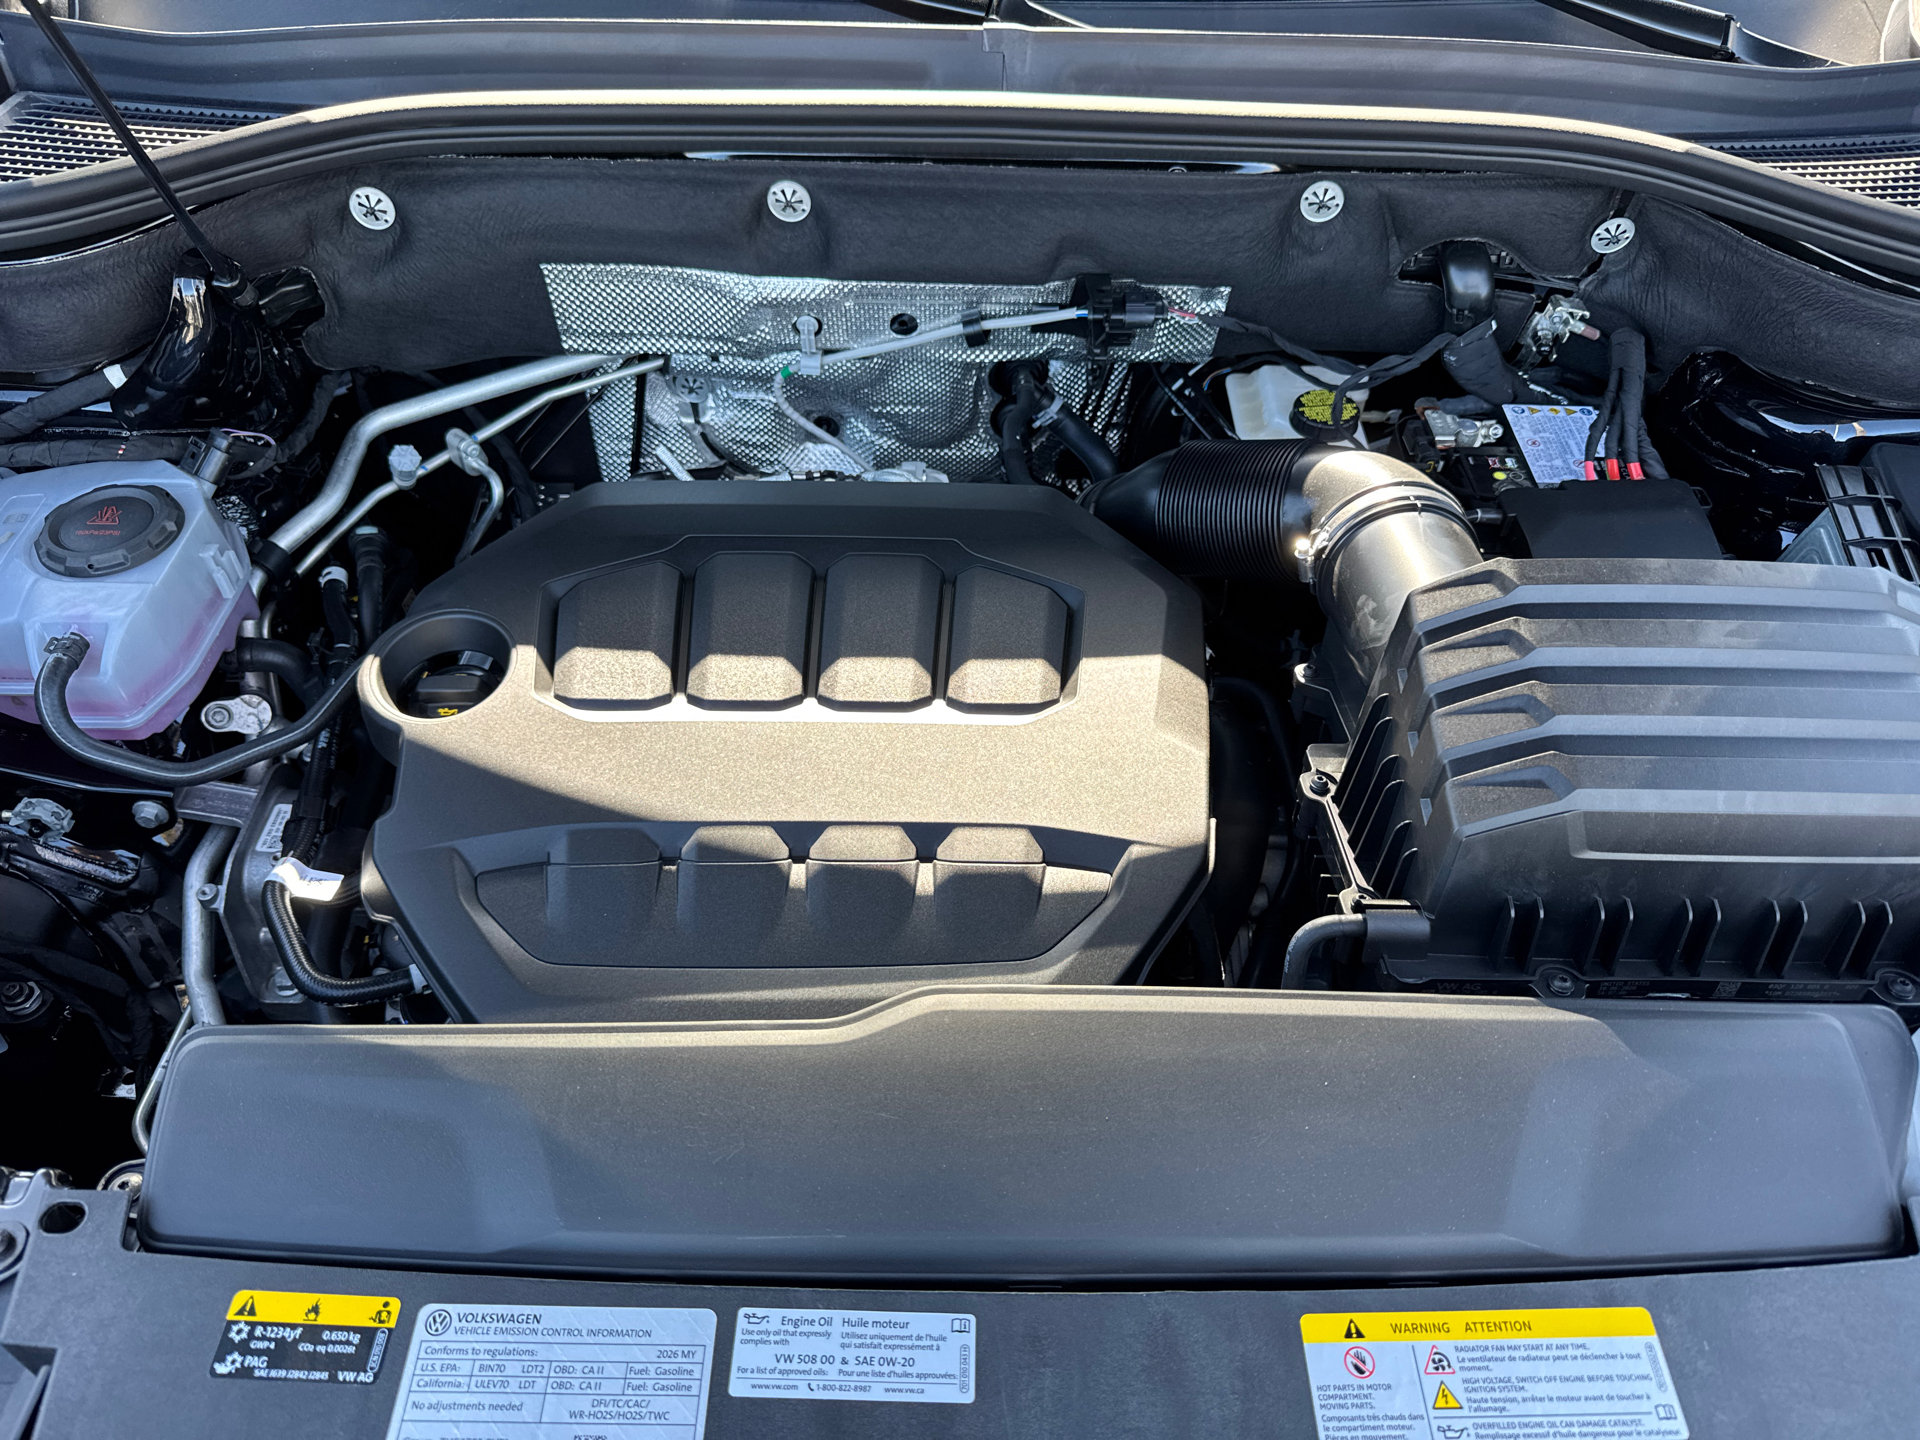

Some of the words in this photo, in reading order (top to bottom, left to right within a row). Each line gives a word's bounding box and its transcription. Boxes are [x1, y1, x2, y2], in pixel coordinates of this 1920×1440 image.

[457, 1312, 542, 1324] VOLKSWAGEN
[781, 1316, 815, 1329] Engine
[818, 1317, 833, 1327] Oil
[842, 1318, 869, 1328] Huile
[871, 1319, 910, 1329] moteur
[454, 1326, 491, 1335] VEHICLE
[493, 1326, 538, 1336] EMISSION
[541, 1328, 584, 1337] CONTROL
[586, 1328, 652, 1338] INFORMATION
[1390, 1322, 1450, 1334] WARNING
[1464, 1320, 1532, 1333] ATTENTION
[254, 1325, 303, 1342] R-1234yf
[322, 1330, 347, 1340] 0.650
[349, 1331, 361, 1344] kg
[756, 1329, 771, 1338] only
[798, 1330, 832, 1340] expressly
[841, 1332, 867, 1340] Utilisez
[869, 1332, 913, 1342] uniquement
[925, 1334, 947, 1342] l'huile
[740, 1338, 771, 1347] complies
[840, 1341, 852, 1350] qui
[854, 1341, 882, 1350] satisfait
[883, 1342, 934, 1352] expressément
[316, 1345, 326, 1354] eq
[424, 1346, 469, 1356] Conforms
[471, 1347, 481, 1356] to
[483, 1347, 538, 1358] regulations:
[656, 1350, 679, 1358] 2026
[681, 1350, 697, 1359] MY
[1454, 1344, 1490, 1352] RADIATOR
[244, 1355, 268, 1368] PAG
[775, 1354, 795, 1364] VW
[797, 1354, 817, 1364] 508
[820, 1355, 835, 1365] 00
[840, 1357, 849, 1365] &
[855, 1356, 875, 1366] SAE
[878, 1357, 915, 1367] 0W-20
[1552, 1354, 1569, 1362] peut
[421, 1363, 437, 1372] U.S.
[440, 1364, 461, 1372] EPA:
[478, 1364, 506, 1373] BIN70
[521, 1364, 545, 1373] LDT2
[553, 1365, 577, 1375] OBD:
[582, 1366, 594, 1375] CA
[629, 1366, 651, 1376] Fuel:
[655, 1367, 694, 1376] Gasoline
[778, 1368, 811, 1377] approved
[813, 1368, 828, 1376] oils:
[338, 1371, 357, 1382] VW
[357, 1372, 374, 1383] AG
[887, 1370, 914, 1378] d'huiles
[915, 1371, 958, 1380] approuvées:
[417, 1378, 464, 1388] California:
[475, 1380, 509, 1389] ULEV70
[518, 1380, 536, 1389] LDT
[551, 1381, 575, 1390] OBD:
[579, 1382, 592, 1390] CA
[626, 1382, 648, 1391] Fuel:
[652, 1382, 692, 1392] Gasoline
[1481, 1376, 1515, 1385] VOLTAGE,
[816, 1384, 871, 1392] 1-800-822-8987
[1464, 1385, 1496, 1394] IGNITION
[1318, 1393, 1375, 1401] COMPARTMENT.
[1466, 1396, 1488, 1404] Haute
[1490, 1395, 1520, 1405] tension,
[1521, 1394, 1546, 1403] arrêter
[1547, 1394, 1554, 1402] le
[411, 1401, 425, 1410] No
[427, 1401, 485, 1412] adjustments
[488, 1402, 523, 1411] needed
[592, 1399, 651, 1408] DFI/TC/CAC/
[1468, 1405, 1510, 1413] l'allumage.
[1321, 1414, 1365, 1423] Composants
[1332, 1423, 1385, 1433] compartiment
[1472, 1422, 1517, 1430] OVERFILLED
[1576, 1419, 1607, 1427] DAMAGE
[1552, 1430, 1576, 1438] d'huile
[1578, 1430, 1616, 1439] dangereux
[1617, 1430, 1633, 1438] pour
